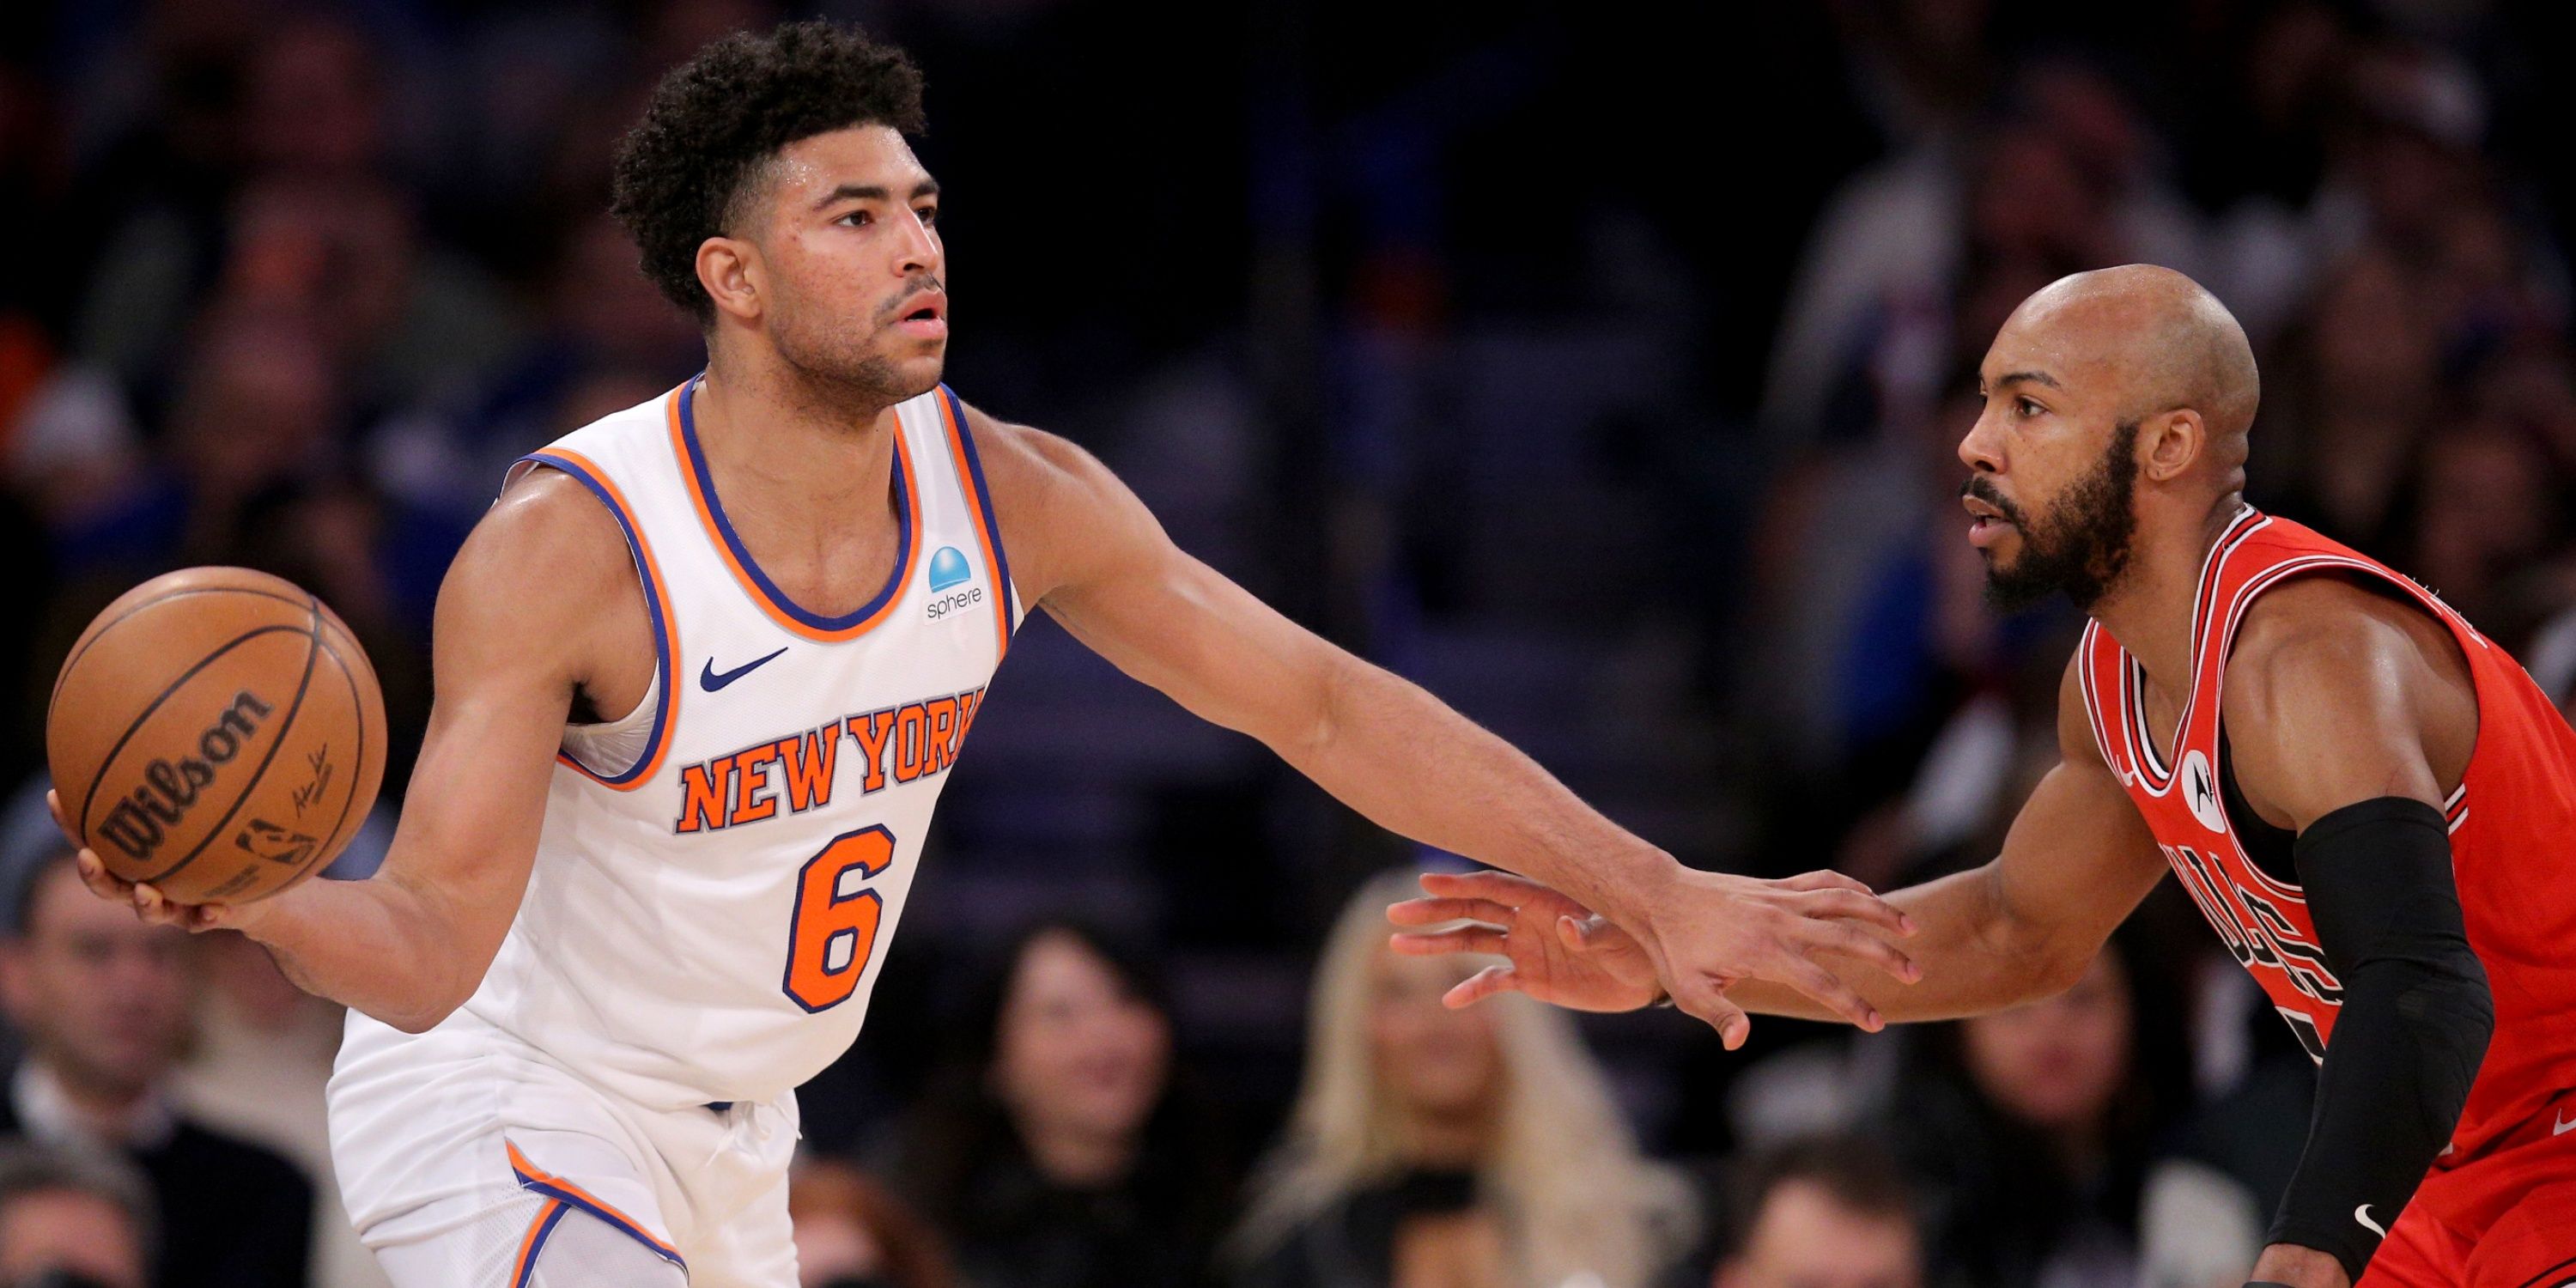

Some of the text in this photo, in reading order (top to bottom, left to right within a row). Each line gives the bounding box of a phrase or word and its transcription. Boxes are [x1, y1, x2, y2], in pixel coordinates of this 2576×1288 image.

[927, 587, 982, 620] sphere
[96, 690, 275, 861] Wilson
[672, 720, 843, 836] NEW
[782, 823, 897, 1015] 6
[2158, 841, 2345, 1006] ULLS
